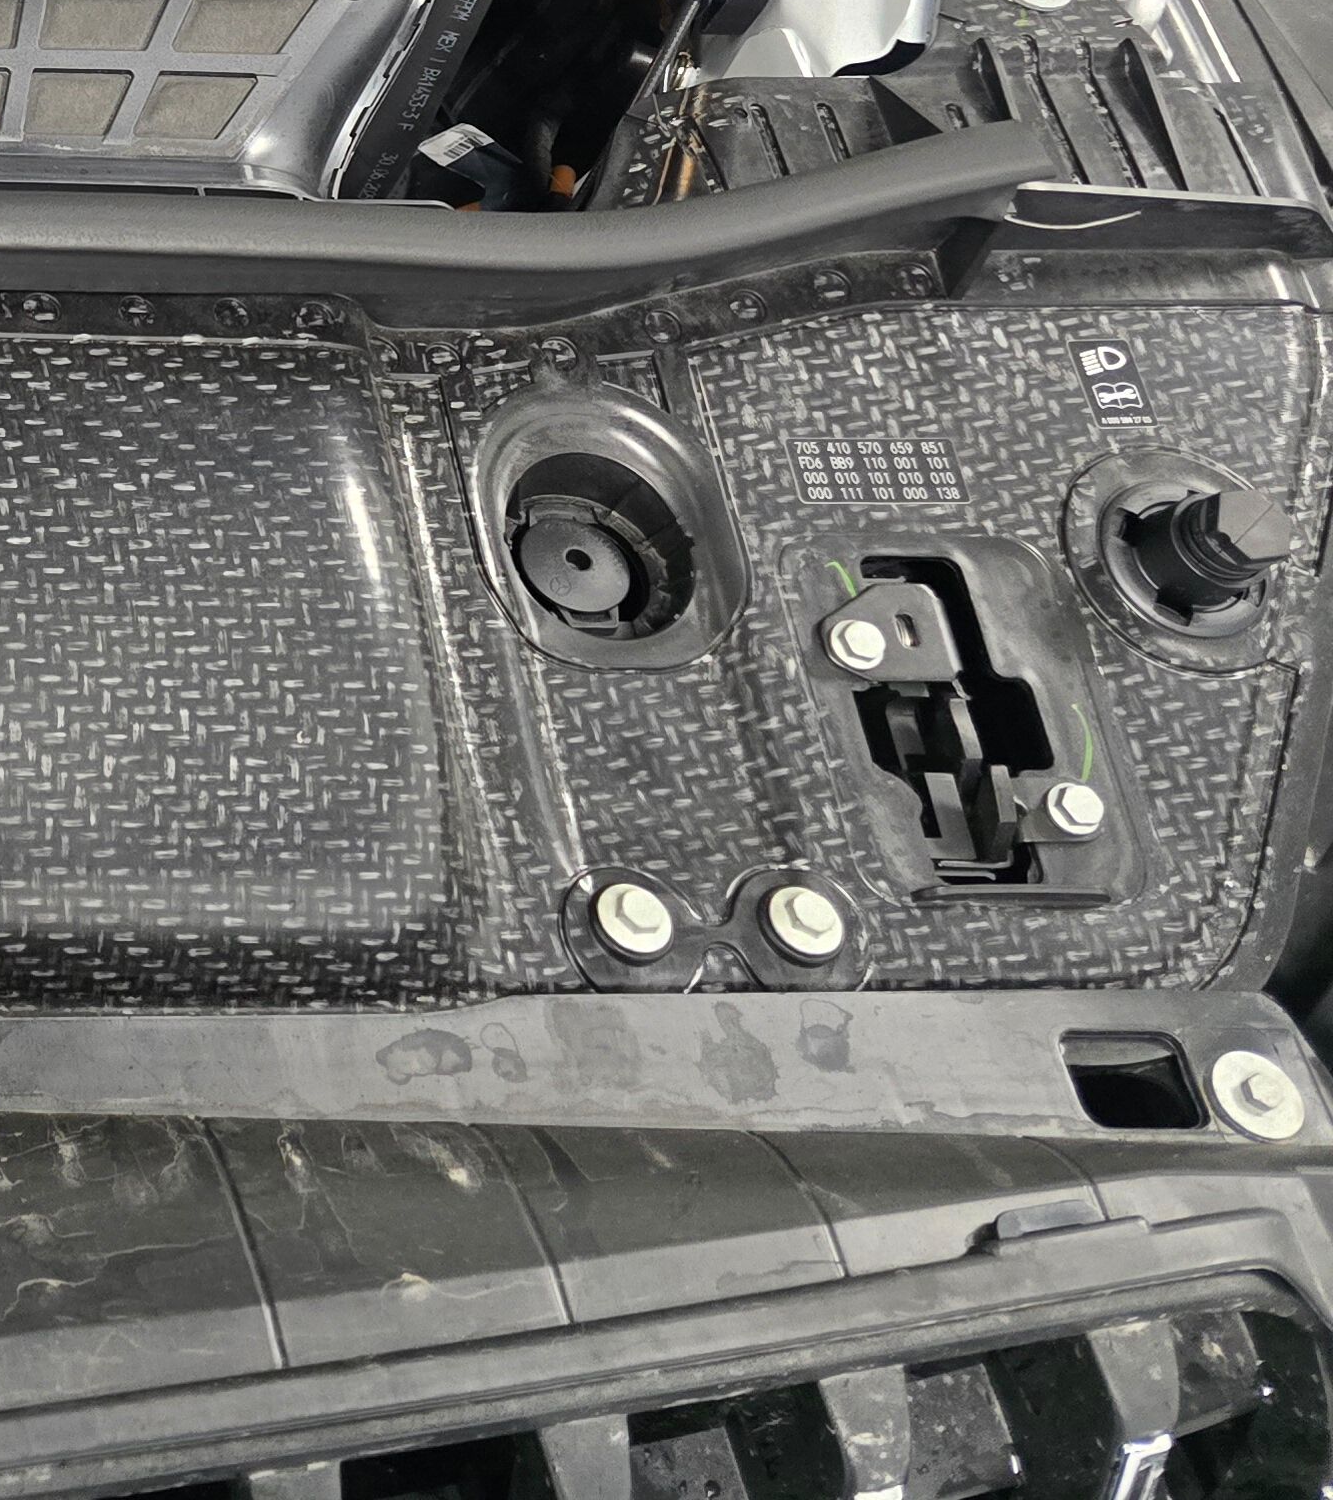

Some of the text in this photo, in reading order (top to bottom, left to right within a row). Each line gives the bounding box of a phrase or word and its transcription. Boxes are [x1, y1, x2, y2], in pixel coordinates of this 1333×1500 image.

[434, 30, 461, 54] MEX
[401, 66, 443, 120] BA1453-3
[396, 122, 414, 132] F
[794, 442, 945, 454] 705 410 570 659 851
[798, 456, 950, 470] FD6 BB9 110 001 101
[803, 471, 956, 485] 000 010 101 010 010
[807, 487, 961, 500] 000 111 101 000 138
